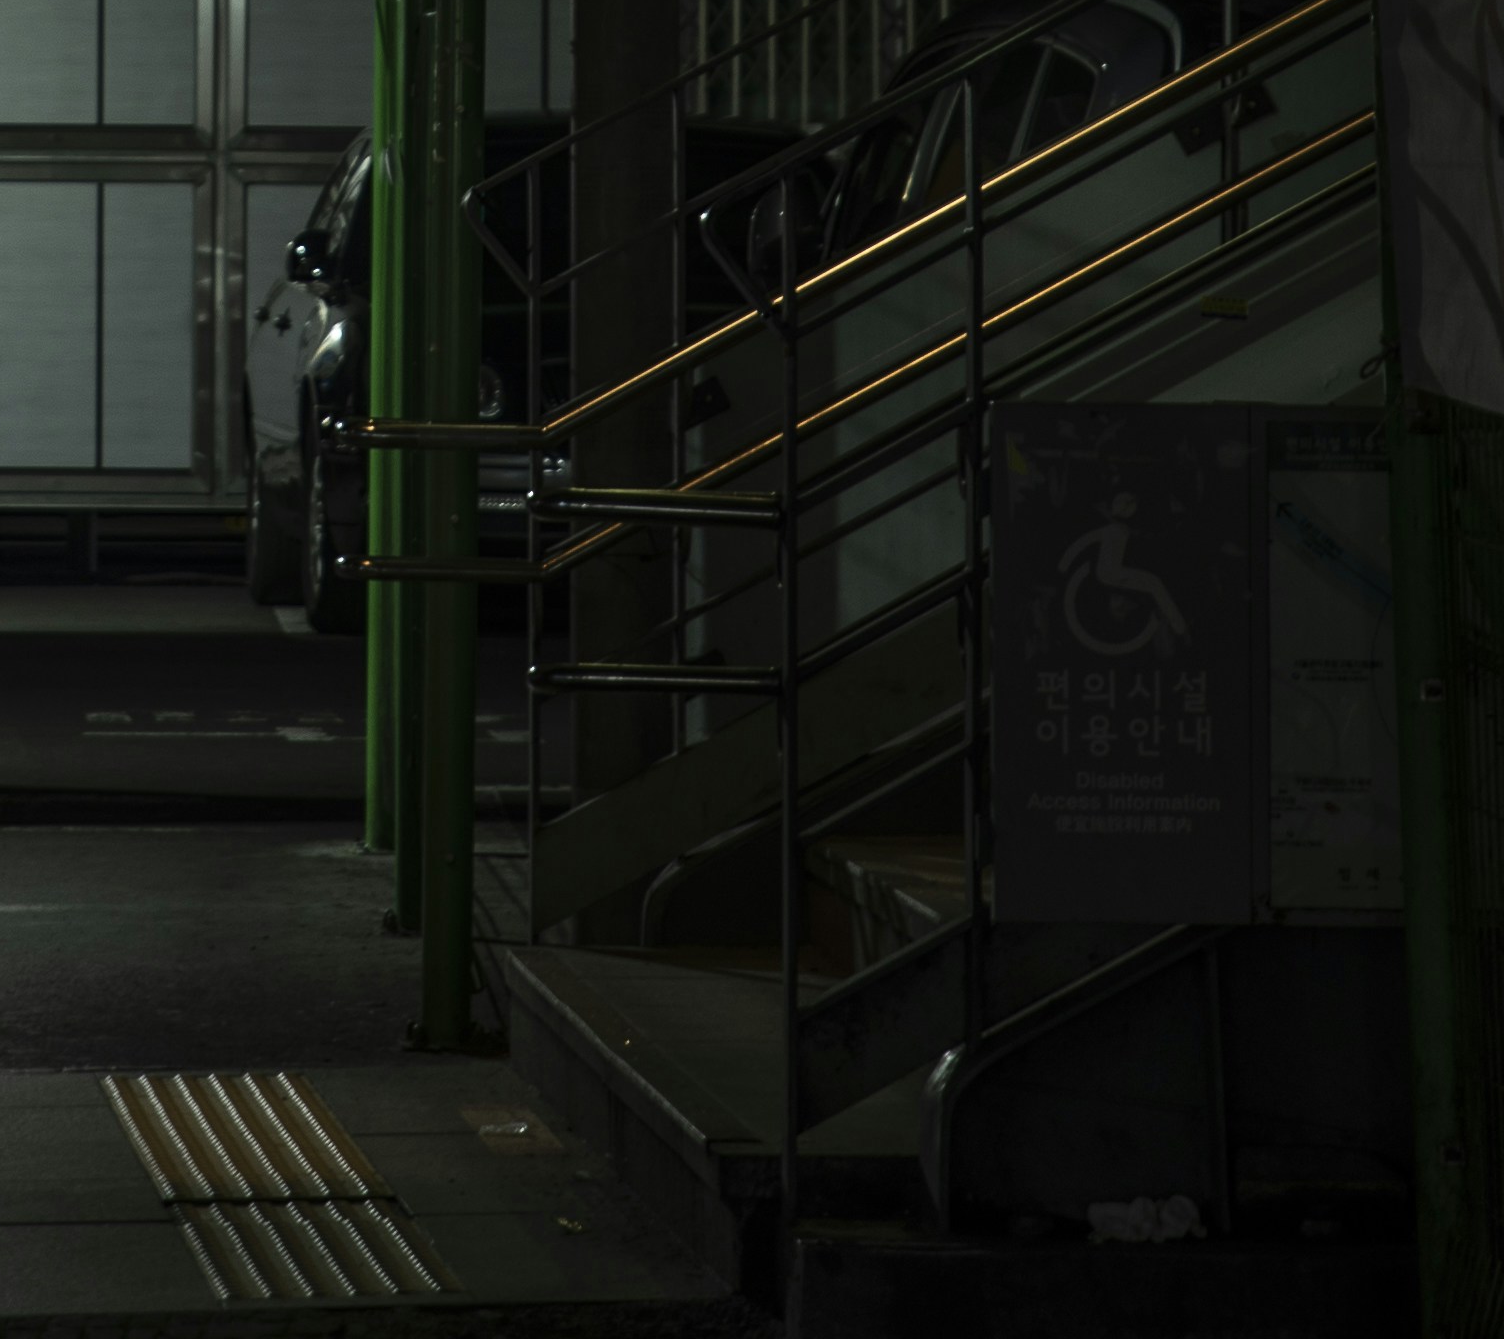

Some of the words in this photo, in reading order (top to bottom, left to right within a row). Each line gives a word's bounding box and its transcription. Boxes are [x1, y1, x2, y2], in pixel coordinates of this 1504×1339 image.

[1035, 667, 1210, 715] 편의시설
[1035, 714, 1216, 759] 이용안내
[1075, 771, 1166, 791] Disabled
[1026, 792, 1103, 812] Access
[1107, 792, 1221, 813] Information
